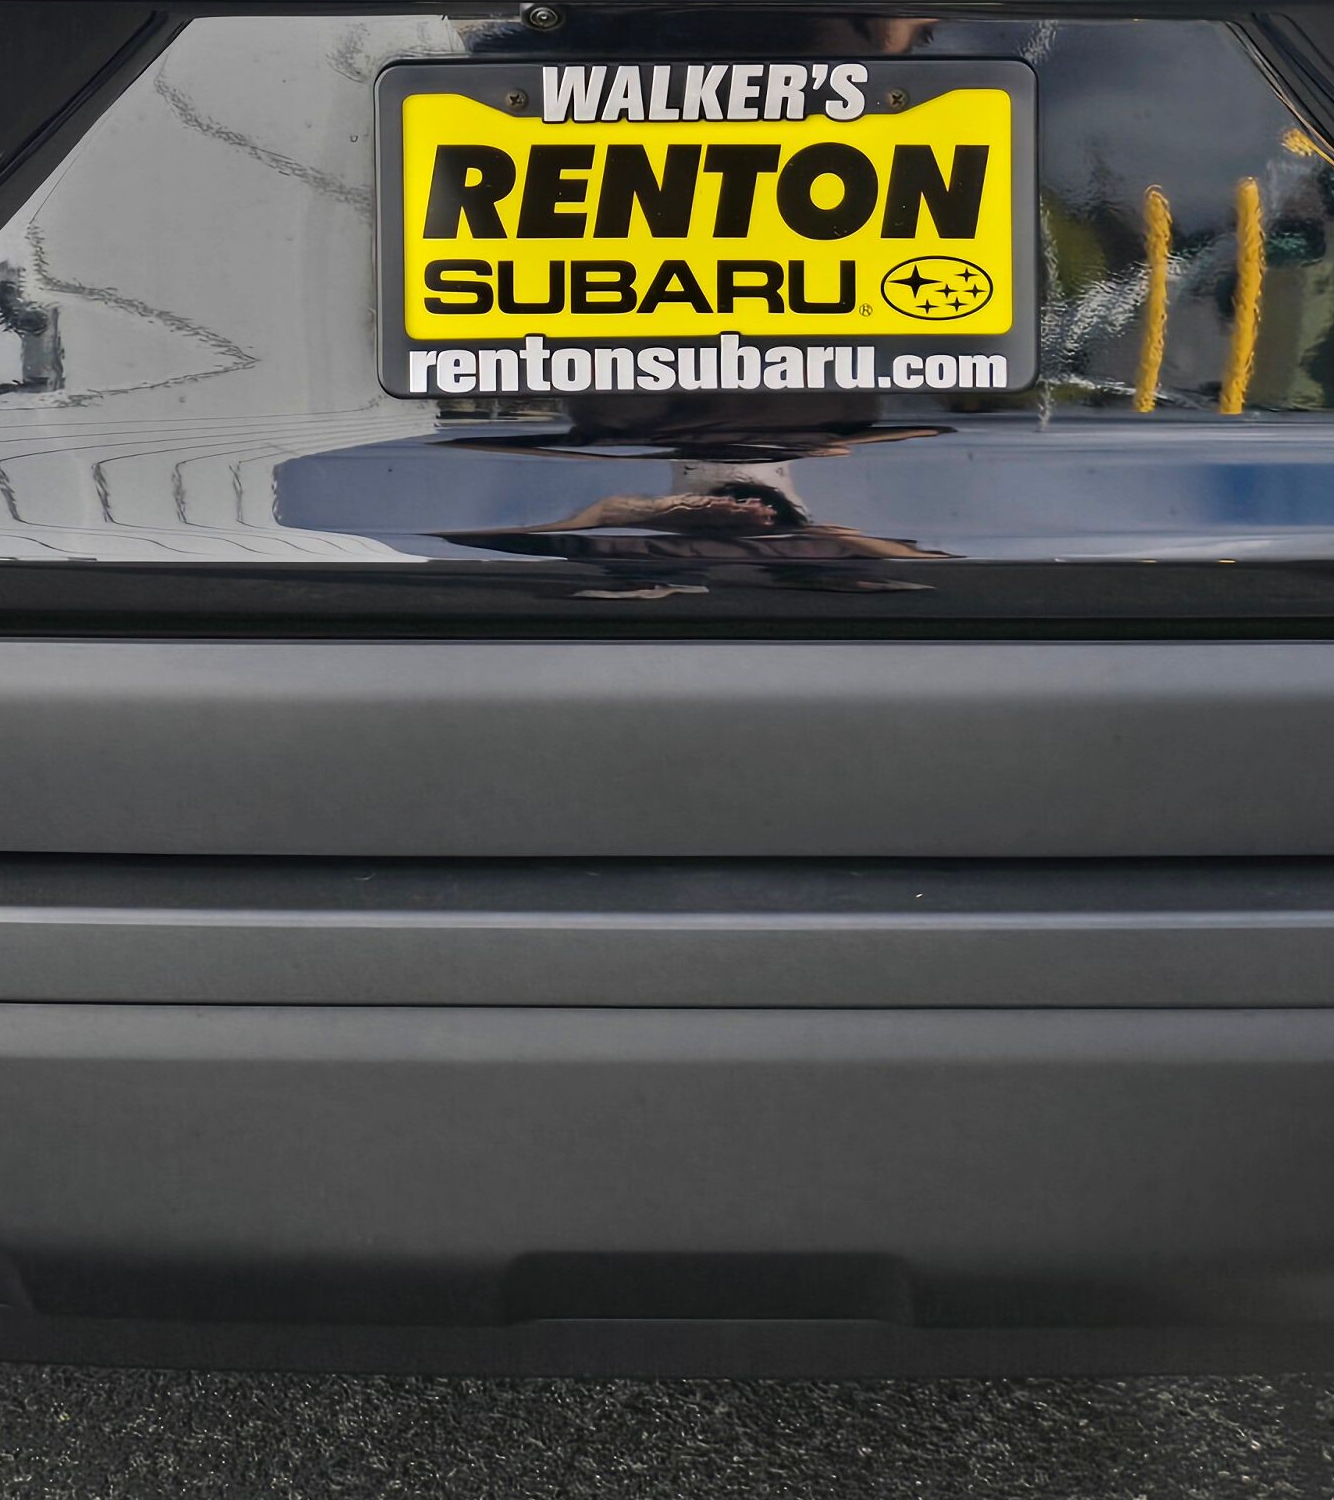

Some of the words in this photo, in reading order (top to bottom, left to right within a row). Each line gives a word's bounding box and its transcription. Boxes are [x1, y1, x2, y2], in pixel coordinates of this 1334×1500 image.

[542, 63, 867, 123] WALKER'S
[423, 142, 989, 240] RENTON
[424, 259, 857, 315] SUBARU
[409, 333, 1007, 393] rentonsubaru.com
